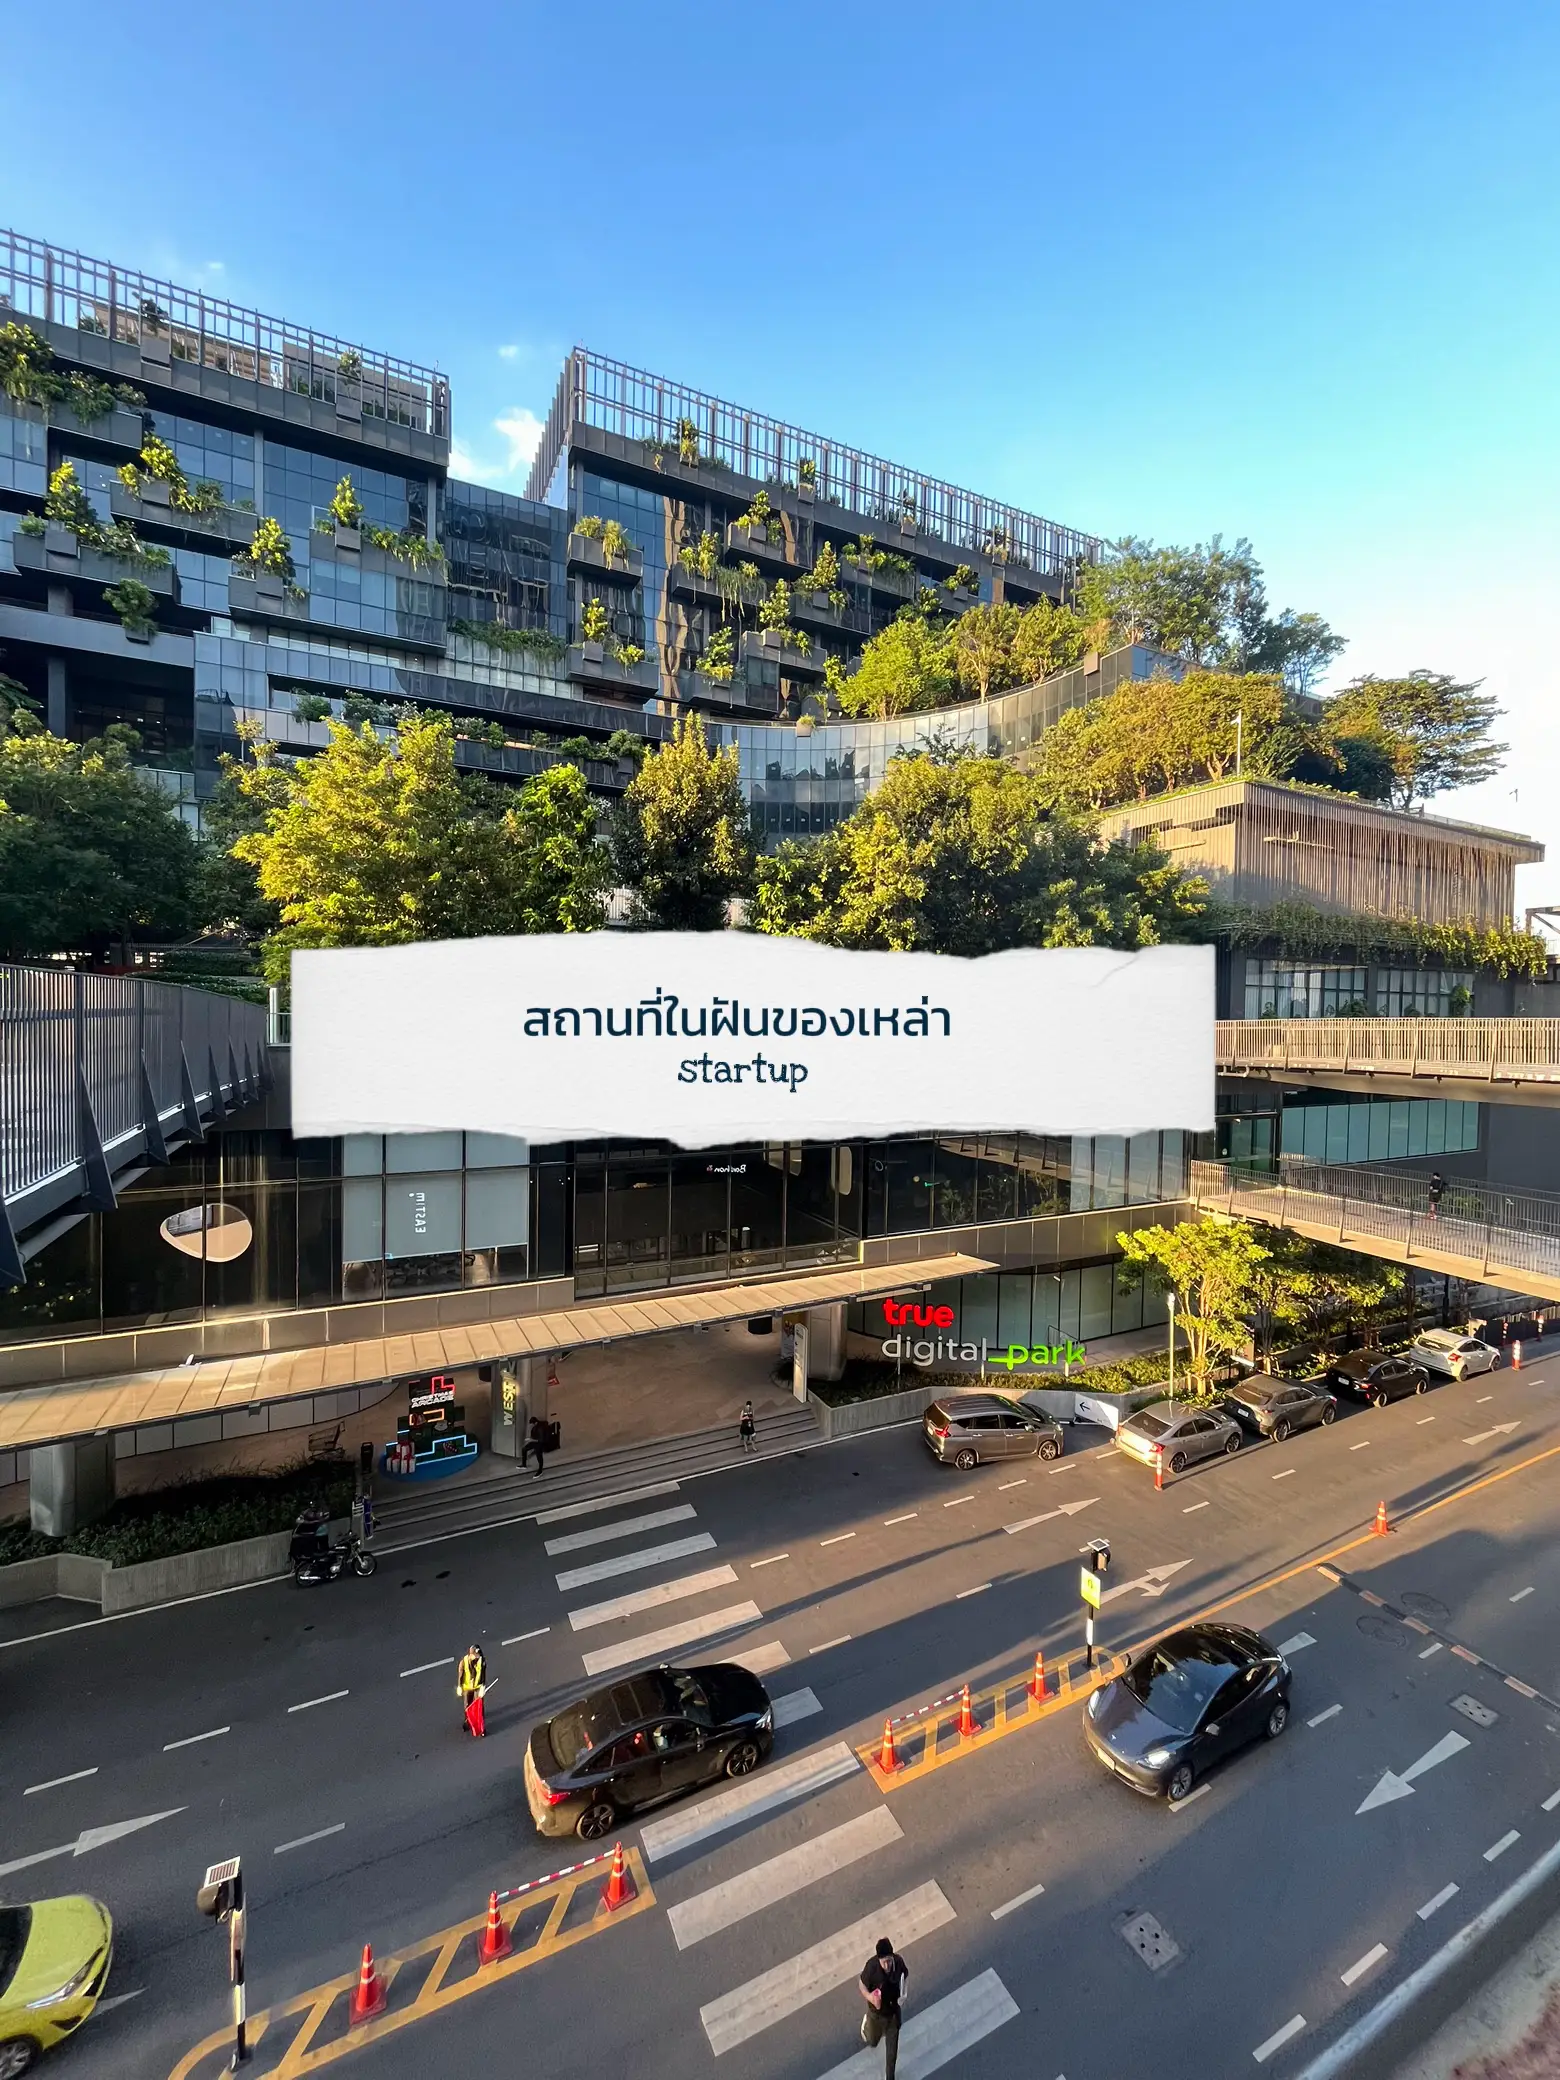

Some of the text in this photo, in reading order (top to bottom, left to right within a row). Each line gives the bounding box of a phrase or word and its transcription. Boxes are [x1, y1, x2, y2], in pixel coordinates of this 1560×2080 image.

[883, 1297, 955, 1328] true
[881, 1333, 1086, 1371] digital park
